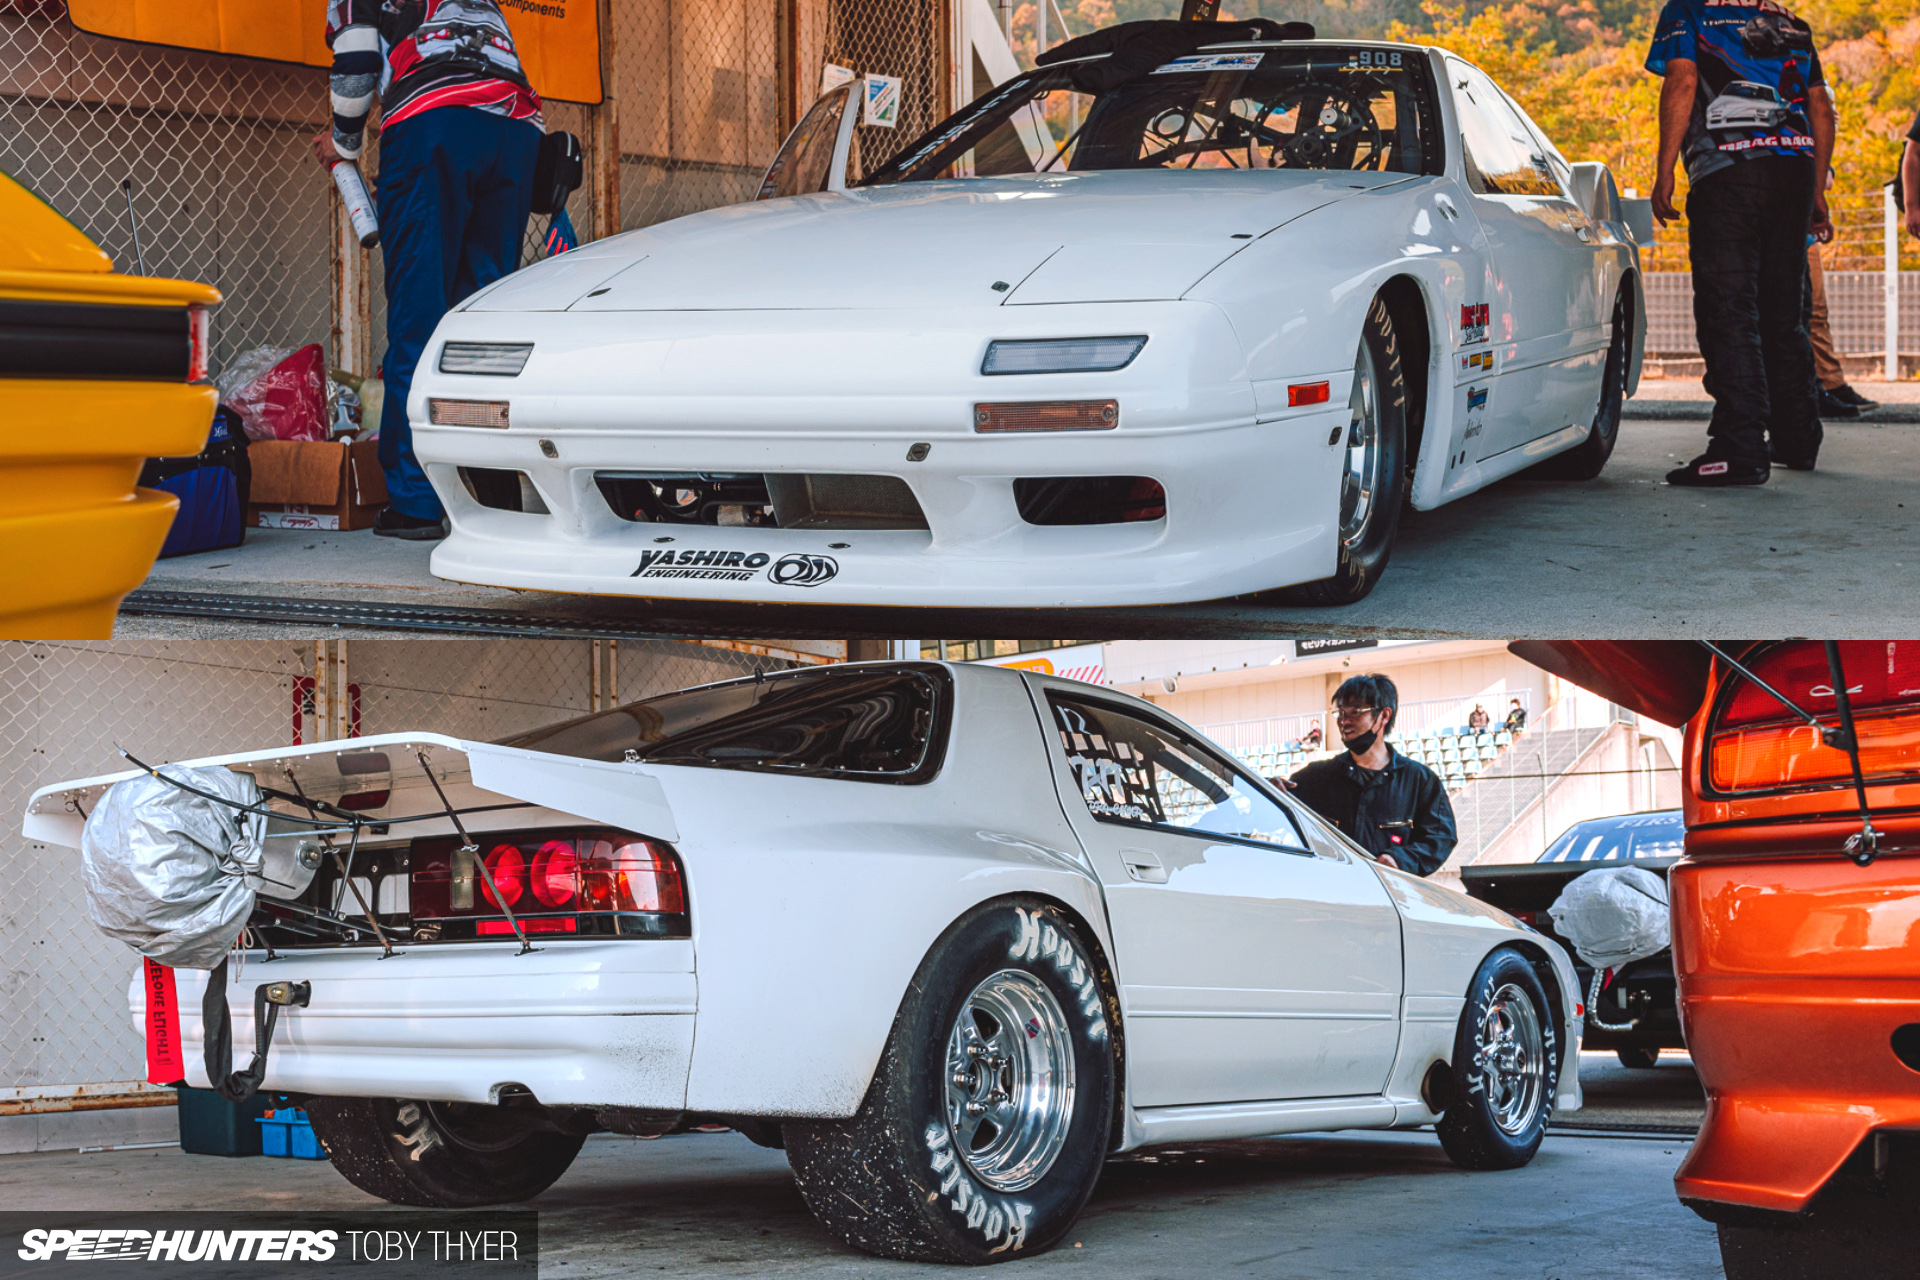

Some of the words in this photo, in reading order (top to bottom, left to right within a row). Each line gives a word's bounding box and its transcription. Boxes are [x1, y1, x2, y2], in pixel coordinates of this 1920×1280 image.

[1359, 51, 1402, 66] 908
[630, 549, 770, 577] YASHIRO
[642, 569, 754, 581] ENGINEERING
